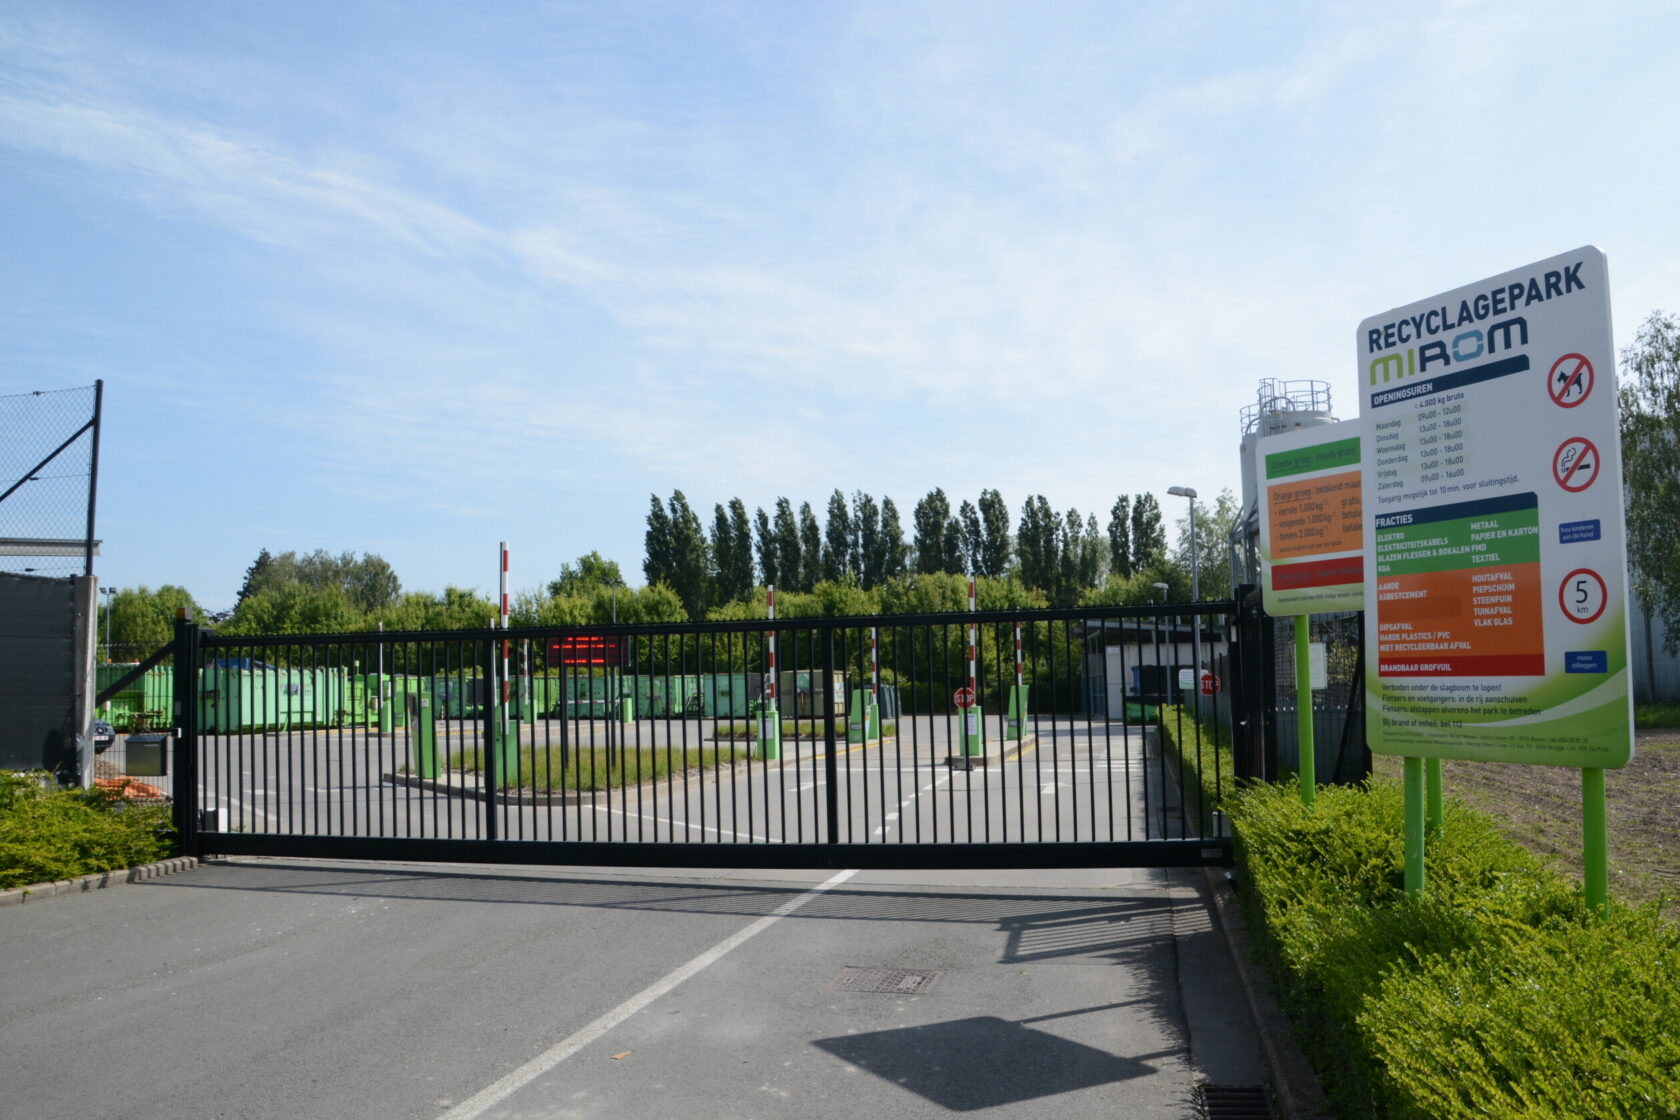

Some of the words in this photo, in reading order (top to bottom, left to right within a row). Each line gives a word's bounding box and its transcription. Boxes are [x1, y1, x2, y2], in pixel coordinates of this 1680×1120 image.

[1368, 261, 1585, 353] RECYCLAGEPARK
[1374, 382, 1433, 405] OPENINGSUREN
[1437, 396, 1446, 405] kg
[1446, 392, 1465, 402] bruto
[1376, 419, 1401, 431] Maandag
[1376, 432, 1399, 443] Dinsdag
[1377, 444, 1406, 454] Woensdag
[1377, 455, 1408, 466] Donderdag
[1377, 469, 1398, 480] Vrijdag
[1378, 480, 1404, 491] Zaterdag
[1377, 494, 1402, 504] Toegang
[1402, 490, 1428, 501] mogelijk
[1429, 488, 1438, 496] tot
[1439, 486, 1447, 495] 10
[1462, 482, 1477, 490] voor
[1376, 514, 1413, 528] FRACTIES
[1470, 520, 1499, 531] METAAL
[1377, 532, 1405, 543] ELEKTRO
[1470, 531, 1496, 542] PAPIER
[1496, 529, 1507, 539] EN
[1507, 526, 1538, 537] KARTON
[1377, 537, 1449, 552] ELEKTRICITEITSKABELS
[1471, 543, 1487, 552] PMD
[1377, 552, 1402, 562] GLAZEN
[1402, 549, 1431, 560] FLESSEN
[1438, 545, 1471, 556] BOKALEN
[1472, 553, 1500, 563] TEXTIEL
[1378, 564, 1391, 572] KGA
[1472, 572, 1513, 583] HOUTAFVAL
[1378, 582, 1400, 591] AARDE
[1472, 583, 1515, 594] PIEPSCHUIM
[1575, 580, 1588, 603] 5
[1378, 590, 1428, 601] ASBESTCEMENT
[1472, 595, 1513, 605] STEENPUIN
[1473, 606, 1513, 616] TUINAFVAL
[1379, 622, 1413, 631] GIPSAFVAL
[1473, 618, 1493, 627] VLAK
[1493, 617, 1513, 626] GLAS
[1379, 633, 1401, 641] HARDE
[1401, 632, 1432, 640] PLASTICS
[1437, 631, 1451, 639] PVC
[1380, 643, 1394, 652] NIET
[1394, 642, 1449, 651] RECYCLEERBAAR
[1449, 641, 1472, 649] AFVAL
[1380, 664, 1419, 672] BRANDBAAR
[1419, 663, 1453, 671] GROFVUIL
[1382, 683, 1410, 692] Verboden
[1411, 683, 1430, 692] onder
[1430, 683, 1439, 691] de
[1440, 683, 1471, 693] slagboom
[1480, 683, 1502, 693] lopen!
[1382, 694, 1407, 702] Fietsers
[1416, 695, 1457, 704] voetgangers:
[1466, 695, 1474, 703] de
[1475, 695, 1484, 704] rij
[1484, 695, 1528, 704] aanschuiven
[1409, 705, 1441, 714] afstappen
[1441, 706, 1470, 714] alvorens
[1470, 706, 1482, 714] het
[1482, 707, 1498, 716] park
[1508, 707, 1541, 716] betreden
[1382, 718, 1391, 727] Bij
[1391, 719, 1410, 727] brand
[1410, 719, 1417, 727] of
[1440, 720, 1451, 728] bel
[1452, 720, 1463, 728] 112
